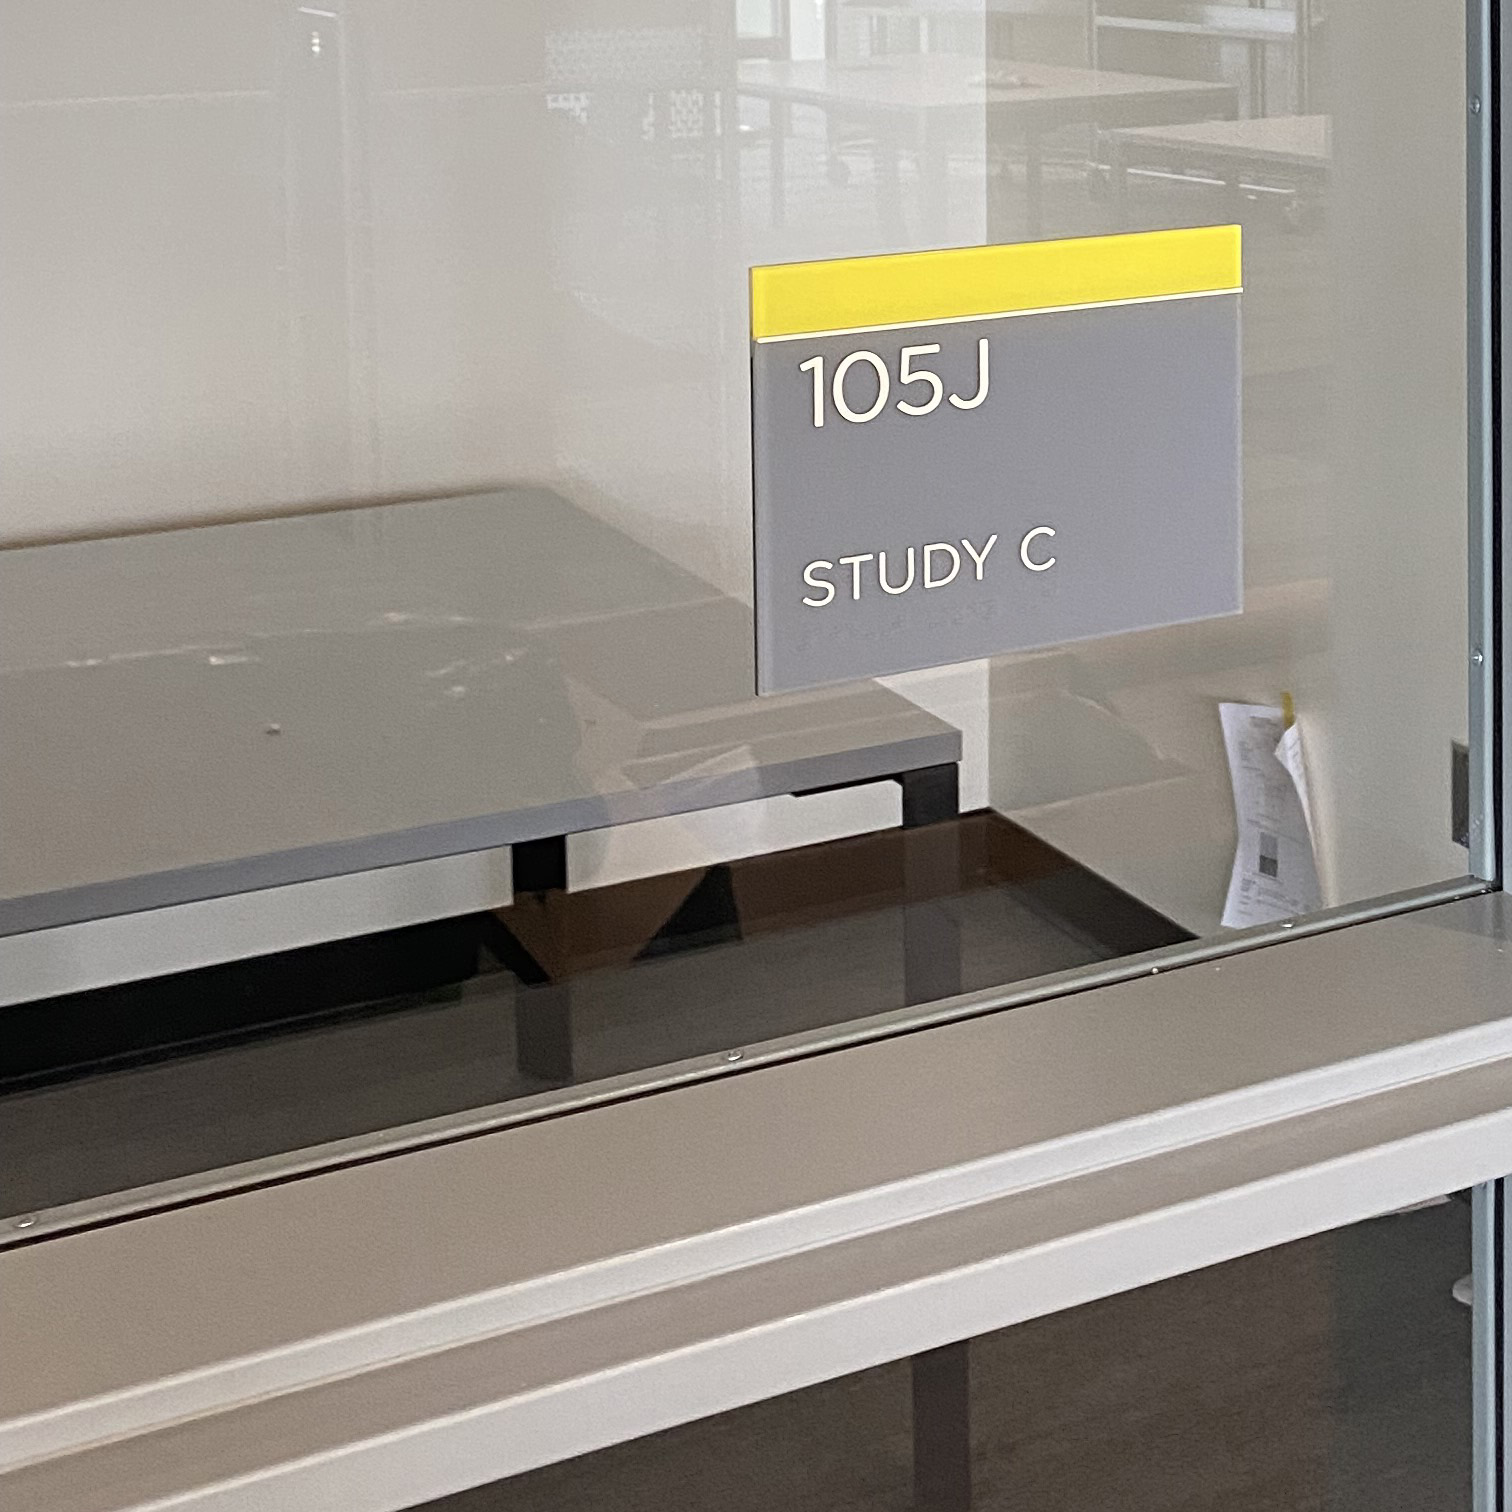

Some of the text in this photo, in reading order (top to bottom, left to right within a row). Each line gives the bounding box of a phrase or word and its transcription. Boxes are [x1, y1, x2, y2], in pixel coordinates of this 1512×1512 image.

[799, 338, 989, 428] 105J
[802, 526, 1056, 607] STUDY C
